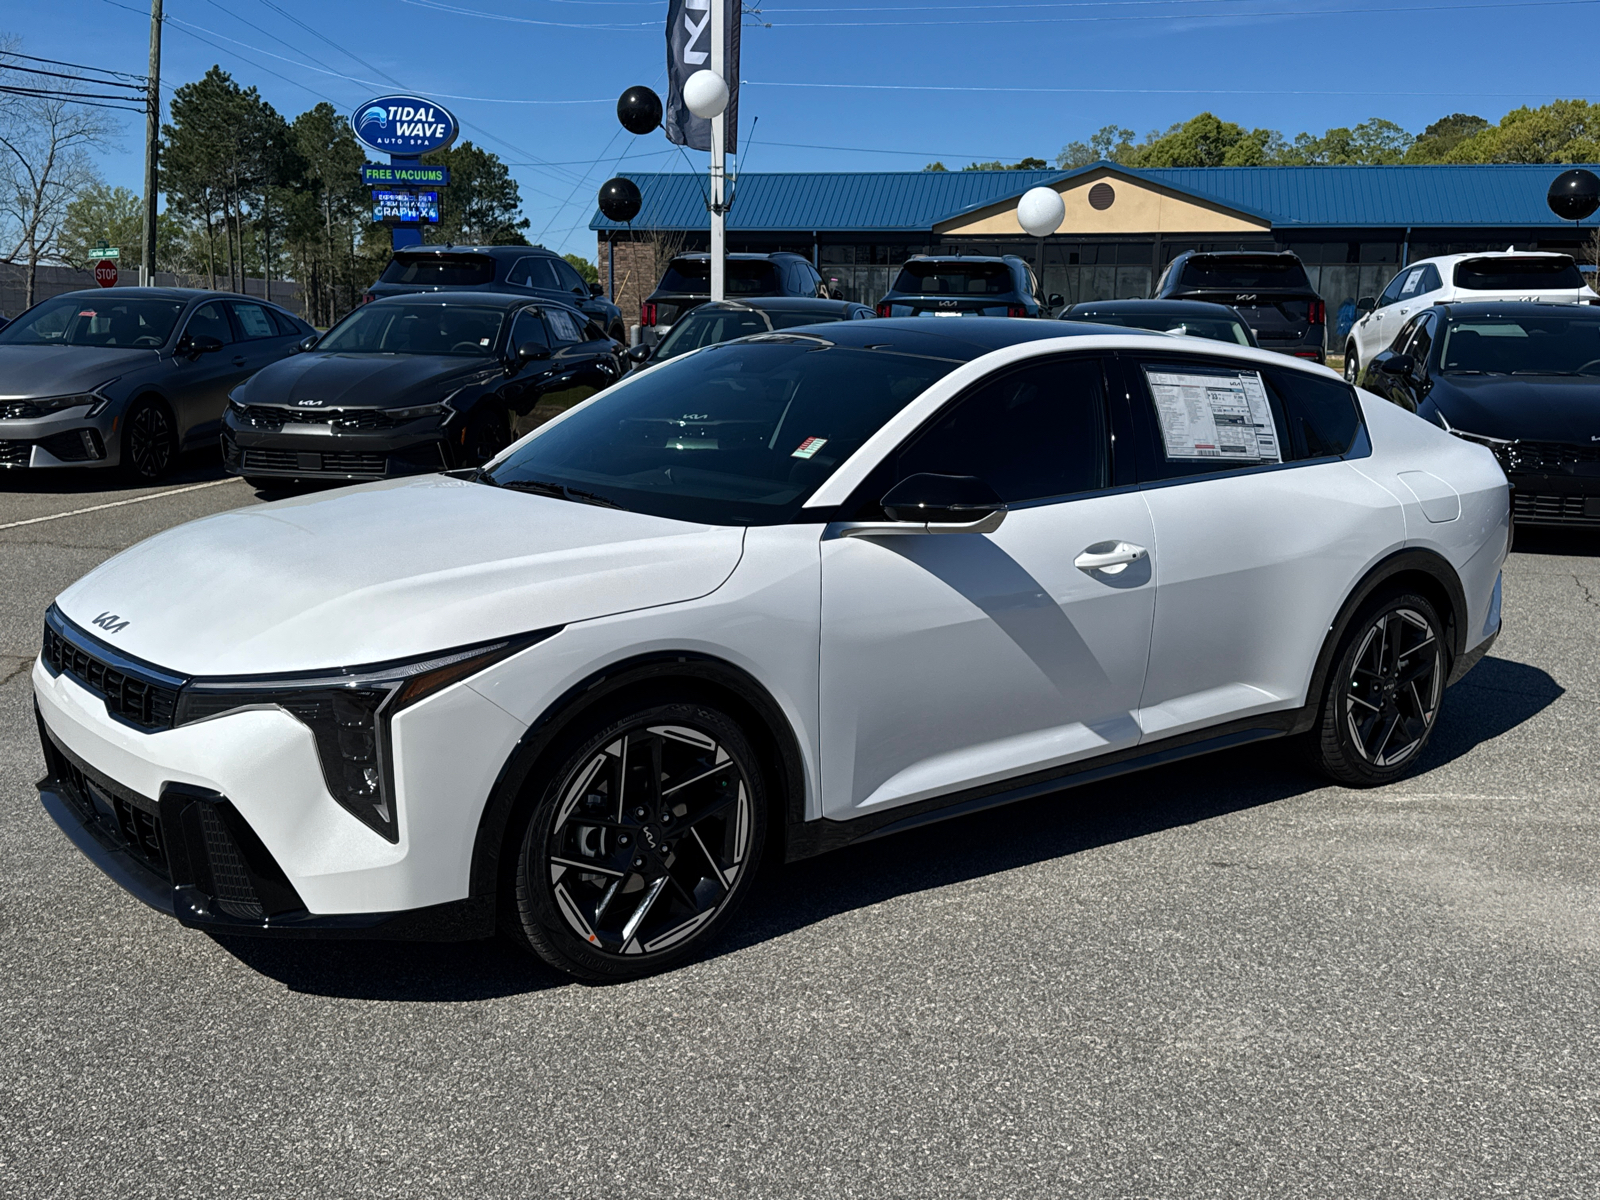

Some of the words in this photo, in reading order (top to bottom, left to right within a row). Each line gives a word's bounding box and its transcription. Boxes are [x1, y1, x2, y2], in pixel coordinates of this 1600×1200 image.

[388, 106, 435, 122] TIDAL
[396, 121, 445, 138] WAVE
[366, 169, 392, 179] FREE
[394, 170, 443, 180] VACUUMS
[96, 268, 117, 280] STOP
[92, 611, 130, 634] KIA
